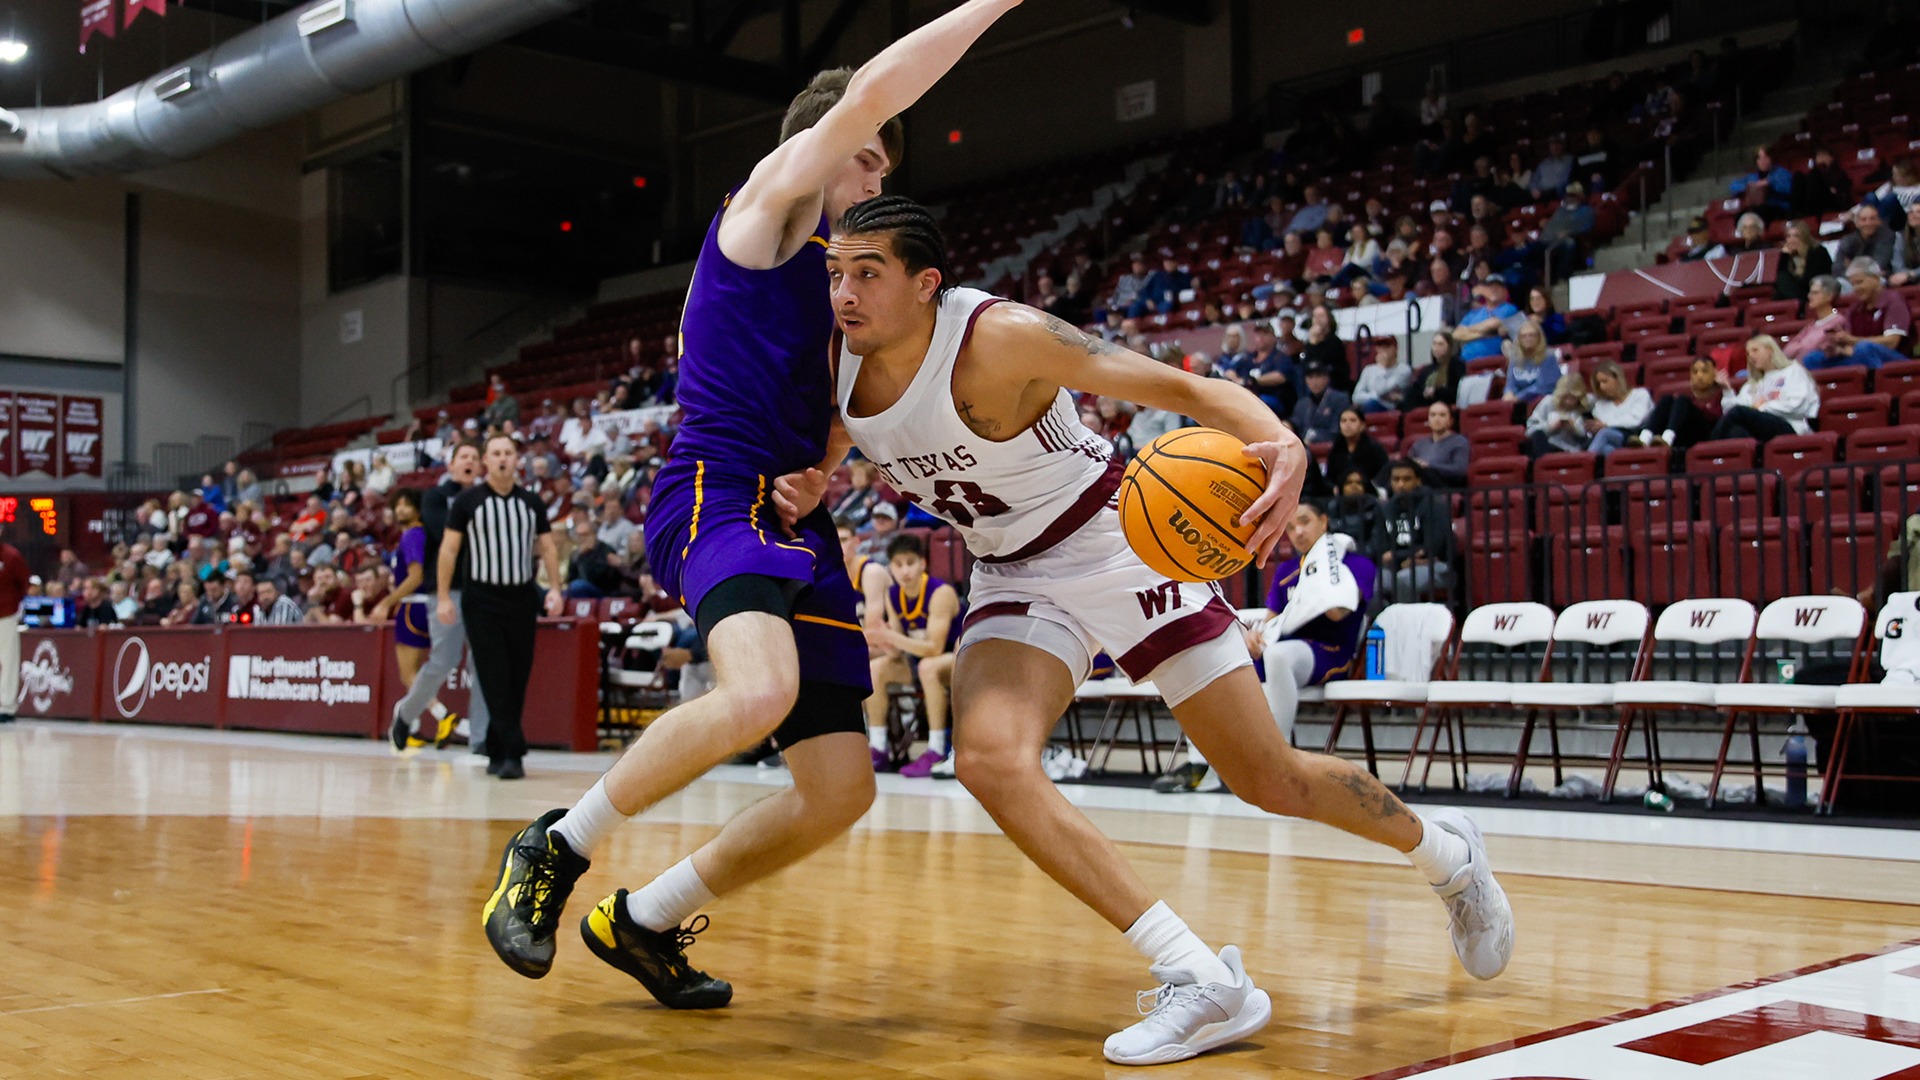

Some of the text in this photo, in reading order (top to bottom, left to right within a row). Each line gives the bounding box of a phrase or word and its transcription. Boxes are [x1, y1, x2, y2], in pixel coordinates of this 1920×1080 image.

[20, 429, 54, 452] WT
[66, 432, 99, 454] WT
[897, 445, 977, 479] TEXAS
[1168, 508, 1245, 576] Wilson
[1135, 579, 1184, 621] WT
[1493, 613, 1523, 631] WT
[1586, 611, 1616, 630] WT
[1690, 609, 1722, 628] WT
[1795, 607, 1828, 627] WT
[150, 655, 211, 700] pepsi
[250, 655, 356, 680] Northwest Texas
[249, 677, 371, 706] Healthcare System
